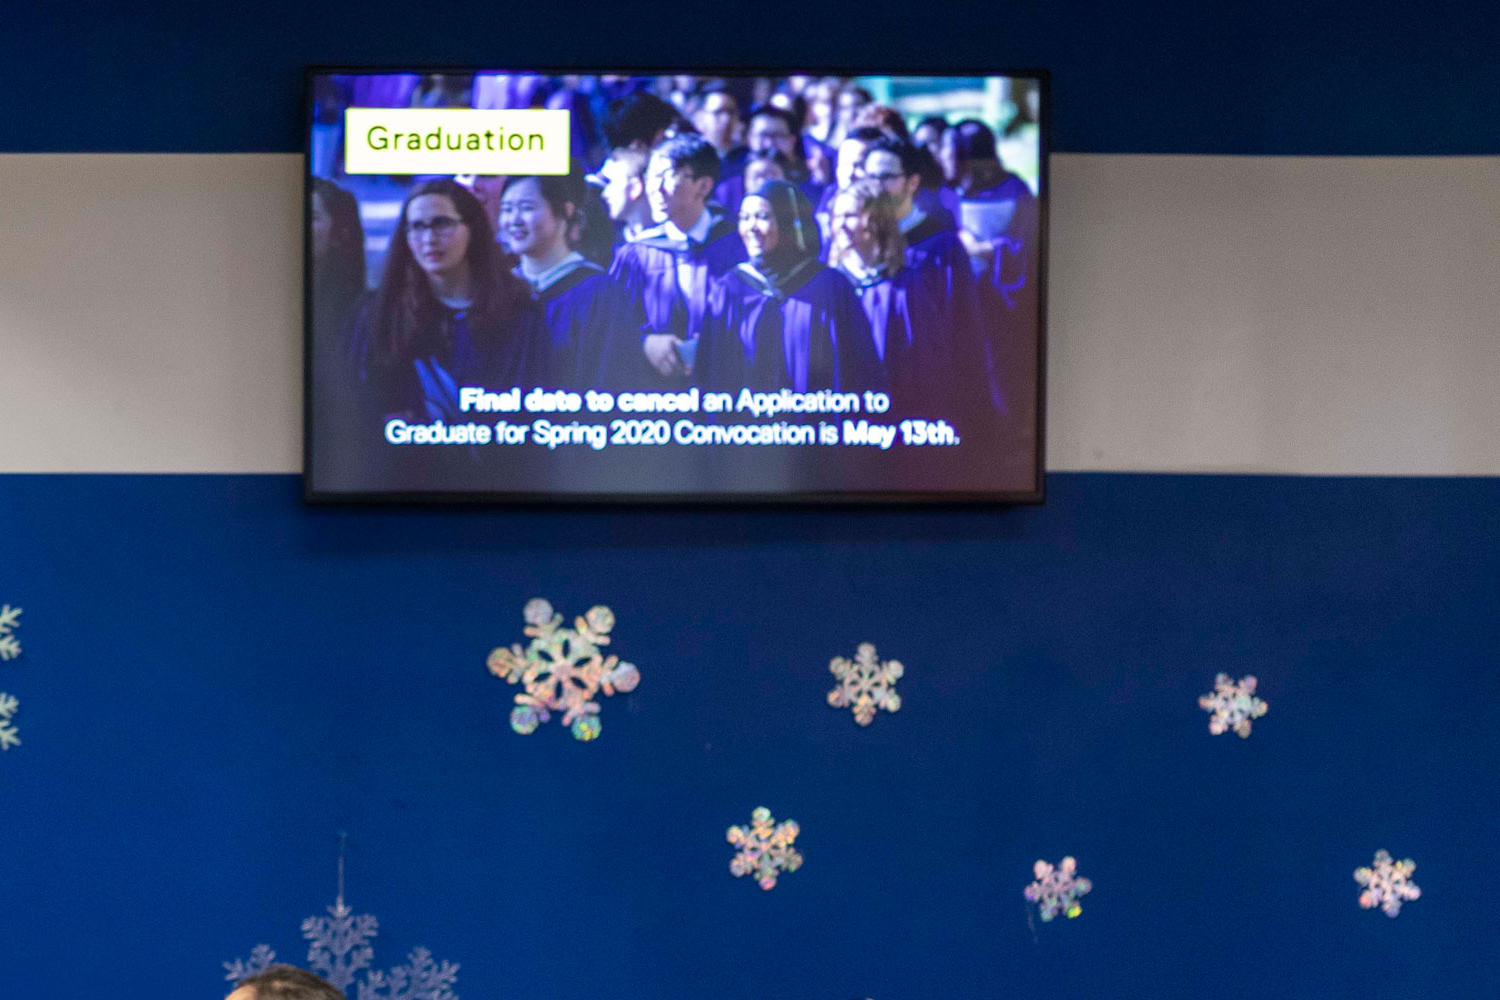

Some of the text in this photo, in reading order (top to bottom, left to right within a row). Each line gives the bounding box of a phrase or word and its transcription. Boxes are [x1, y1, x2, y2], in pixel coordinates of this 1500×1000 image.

[366, 125, 545, 152] Graduation
[459, 388, 890, 418] Final date to cancel an Application to
[385, 420, 960, 449] Graduate for Spring 2020 Convocation is May 13th.
